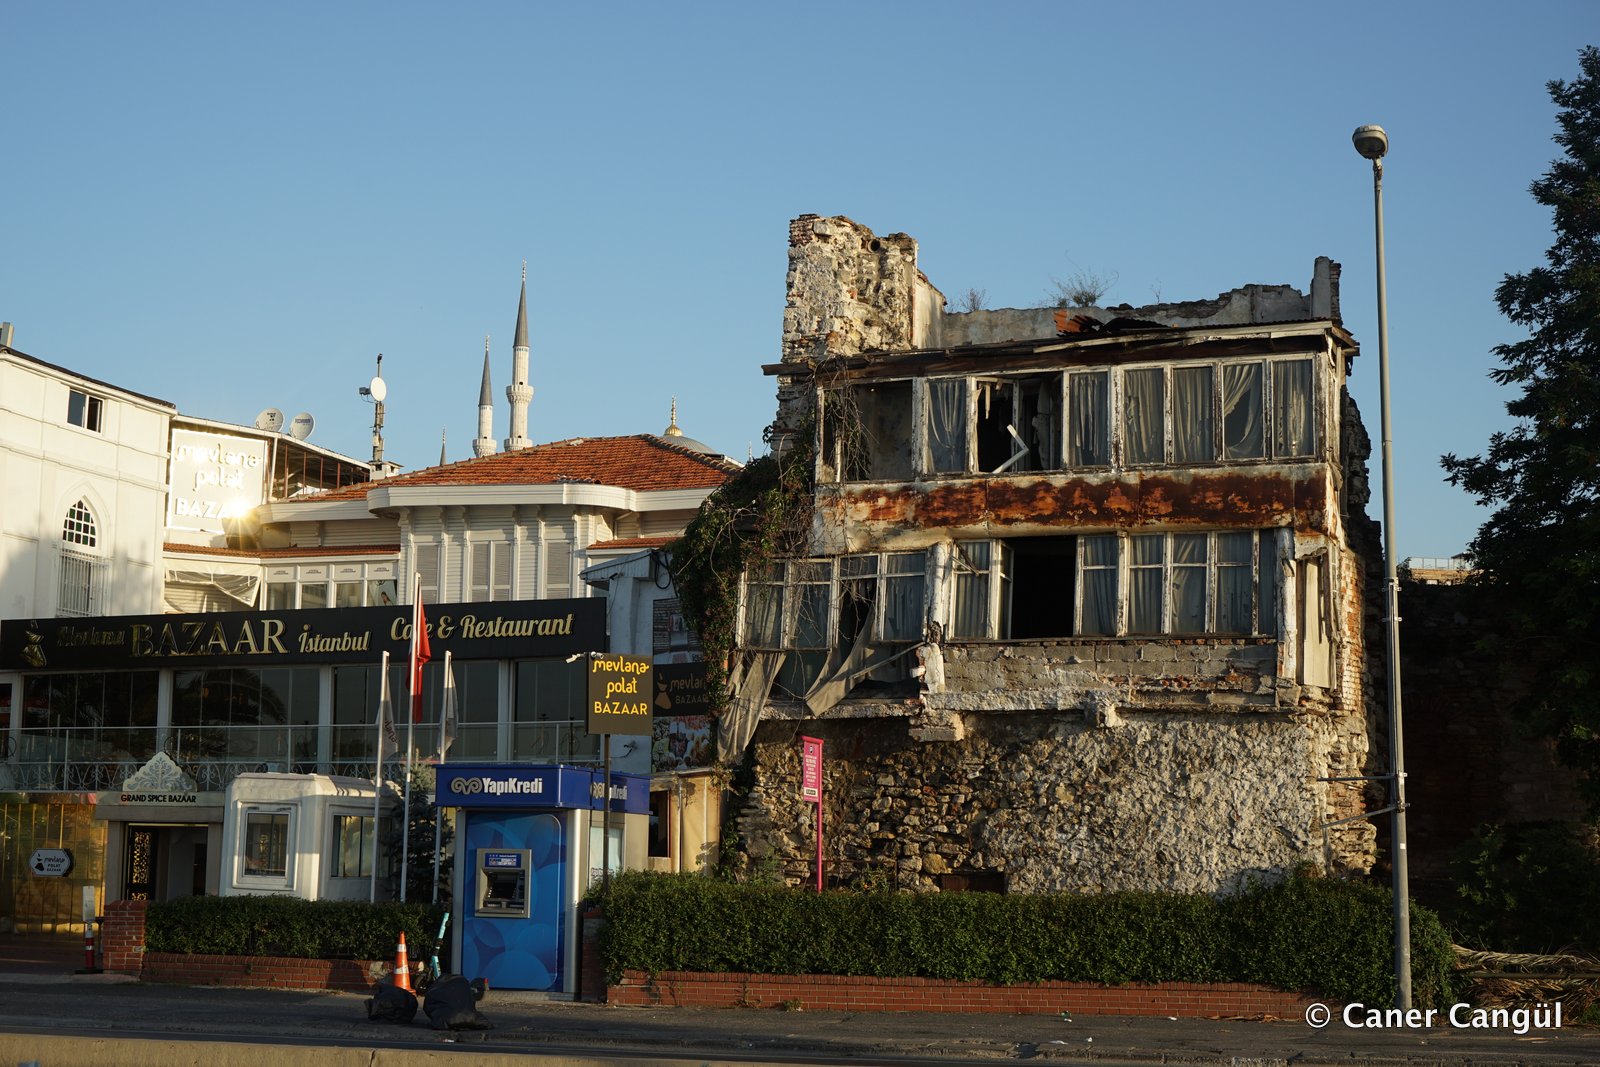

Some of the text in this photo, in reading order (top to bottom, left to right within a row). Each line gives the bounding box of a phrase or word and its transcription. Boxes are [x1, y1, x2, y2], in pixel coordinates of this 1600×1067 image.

[193, 466, 243, 493] polat
[175, 498, 250, 520] BAZA
[129, 619, 288, 657] BAZAAR
[298, 623, 371, 653] İstanbul
[391, 617, 433, 641] Cae
[437, 615, 456, 639] &
[460, 613, 575, 639] Restaurant
[592, 656, 650, 675] mevlana
[605, 676, 638, 699] polat
[670, 672, 706, 692] mevlan
[594, 701, 648, 715] BAZAAR
[482, 777, 543, 796] YapıKredi
[121, 794, 197, 803] GRAND SPICE BAZAAR
